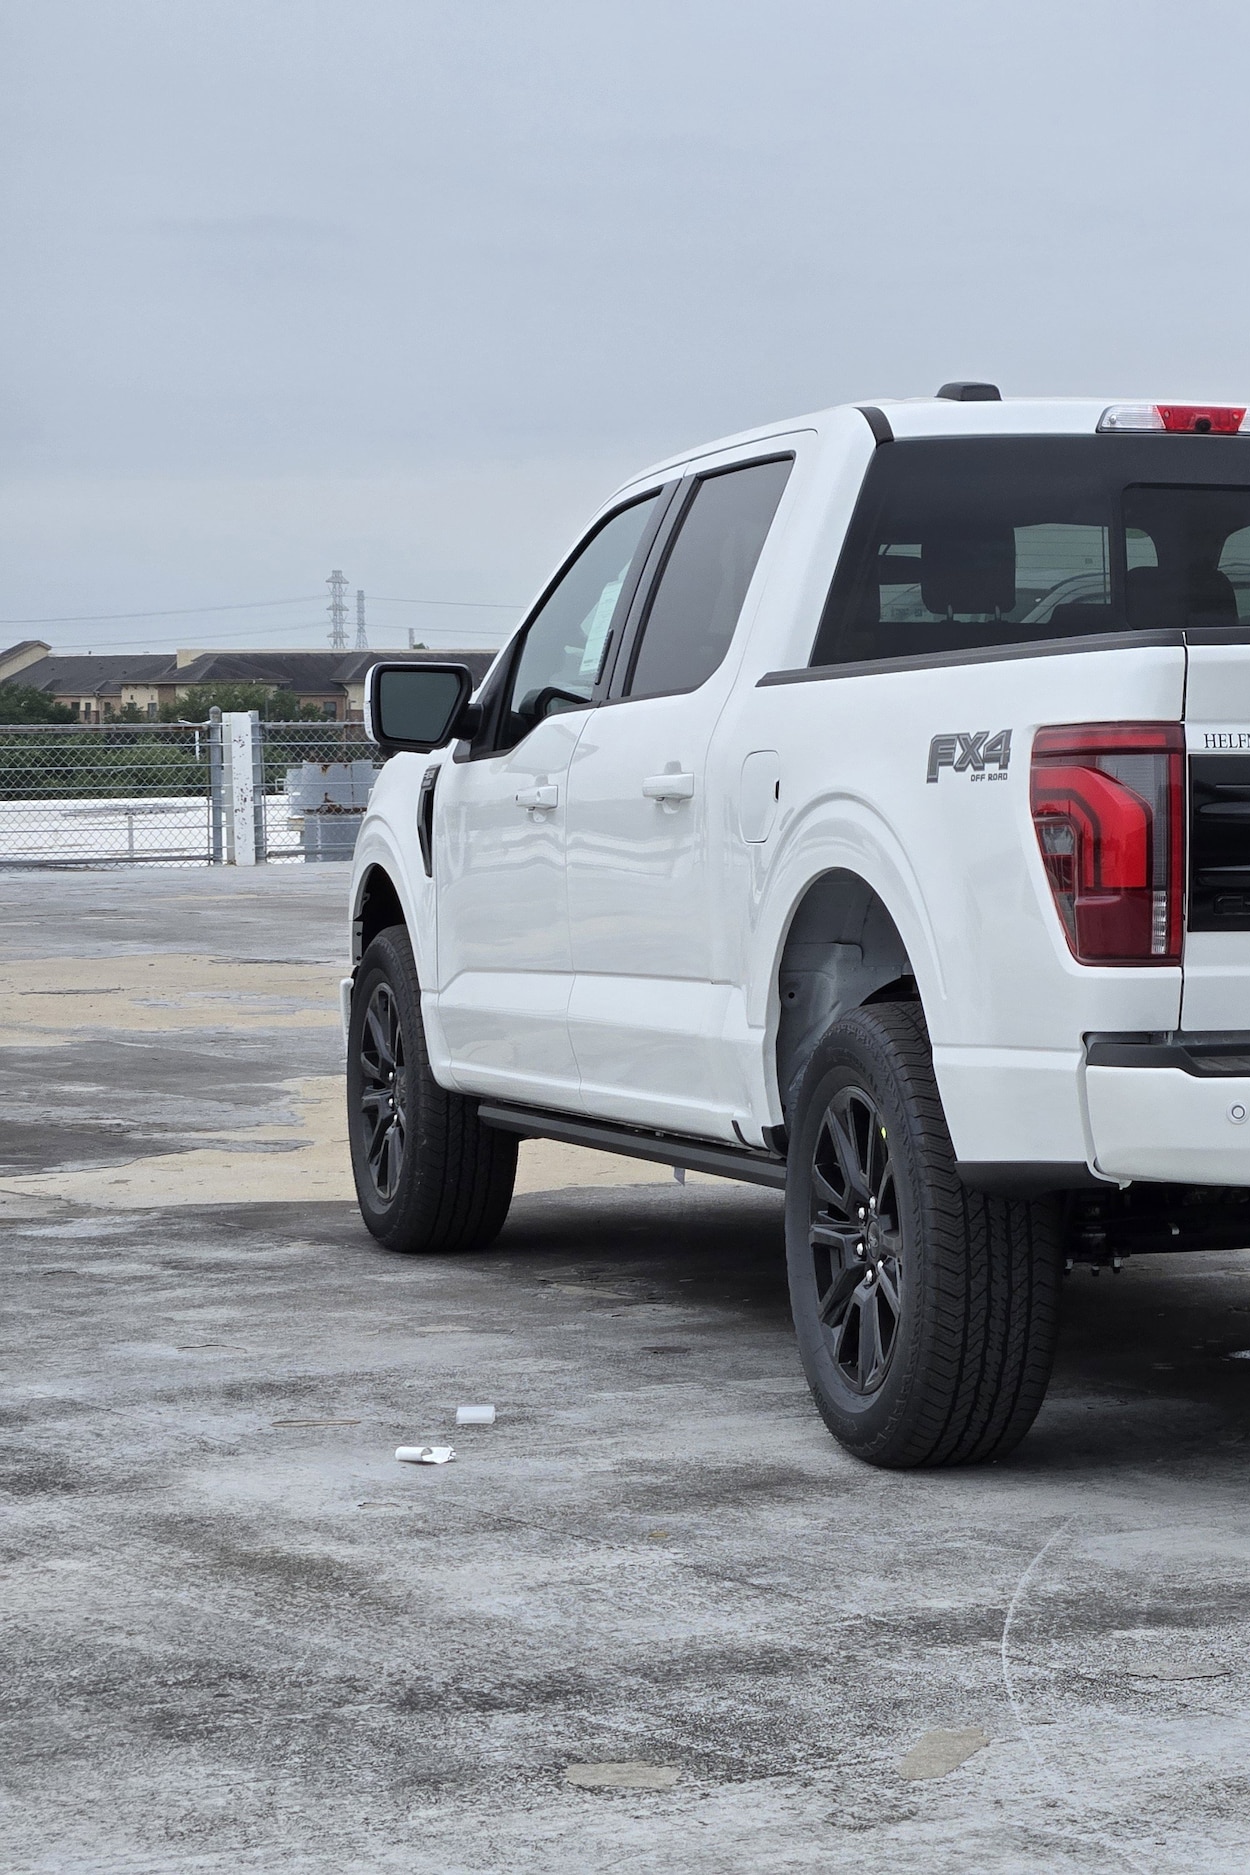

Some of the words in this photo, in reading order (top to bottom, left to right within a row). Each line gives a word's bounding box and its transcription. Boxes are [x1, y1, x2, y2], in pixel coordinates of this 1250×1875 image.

[926, 728, 1013, 784] FX4
[970, 773, 986, 783] OFF
[987, 772, 1008, 782] ROAD
